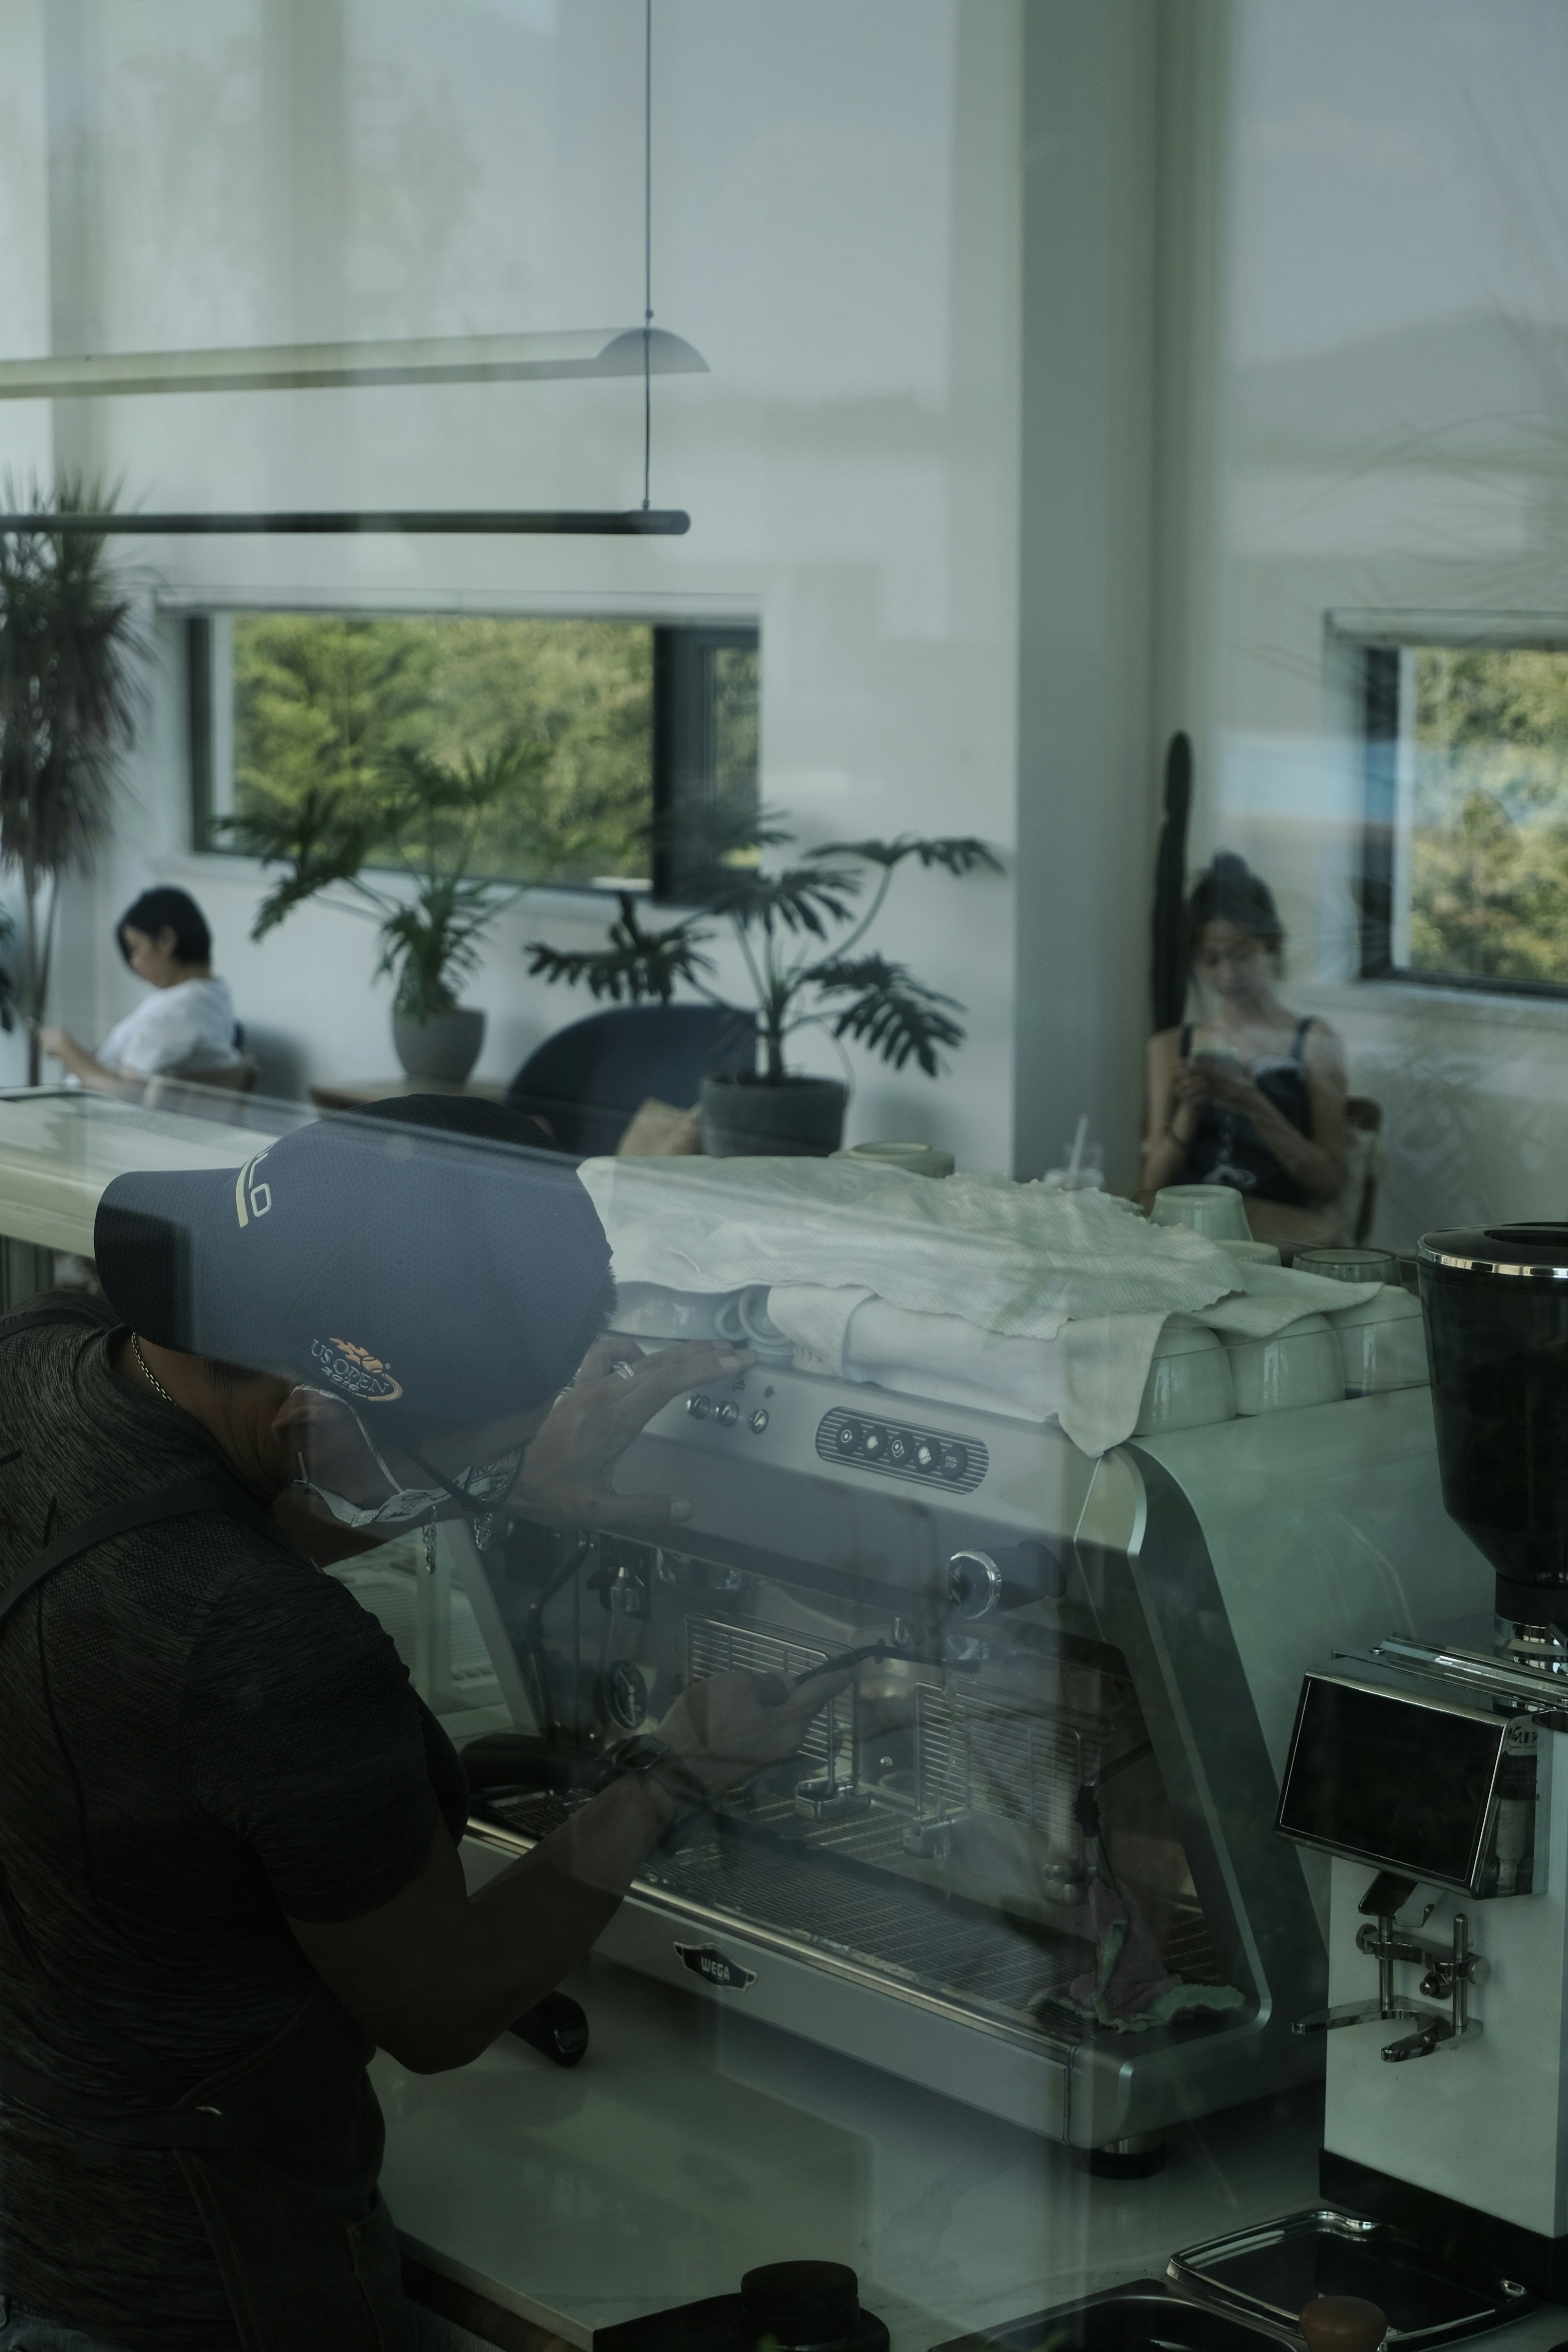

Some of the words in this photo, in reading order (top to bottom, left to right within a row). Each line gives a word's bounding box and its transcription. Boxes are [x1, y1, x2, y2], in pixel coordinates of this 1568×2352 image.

[311, 1339, 333, 1363] US
[333, 1358, 390, 1395] OPEN
[701, 1957, 730, 1981] WEGA
